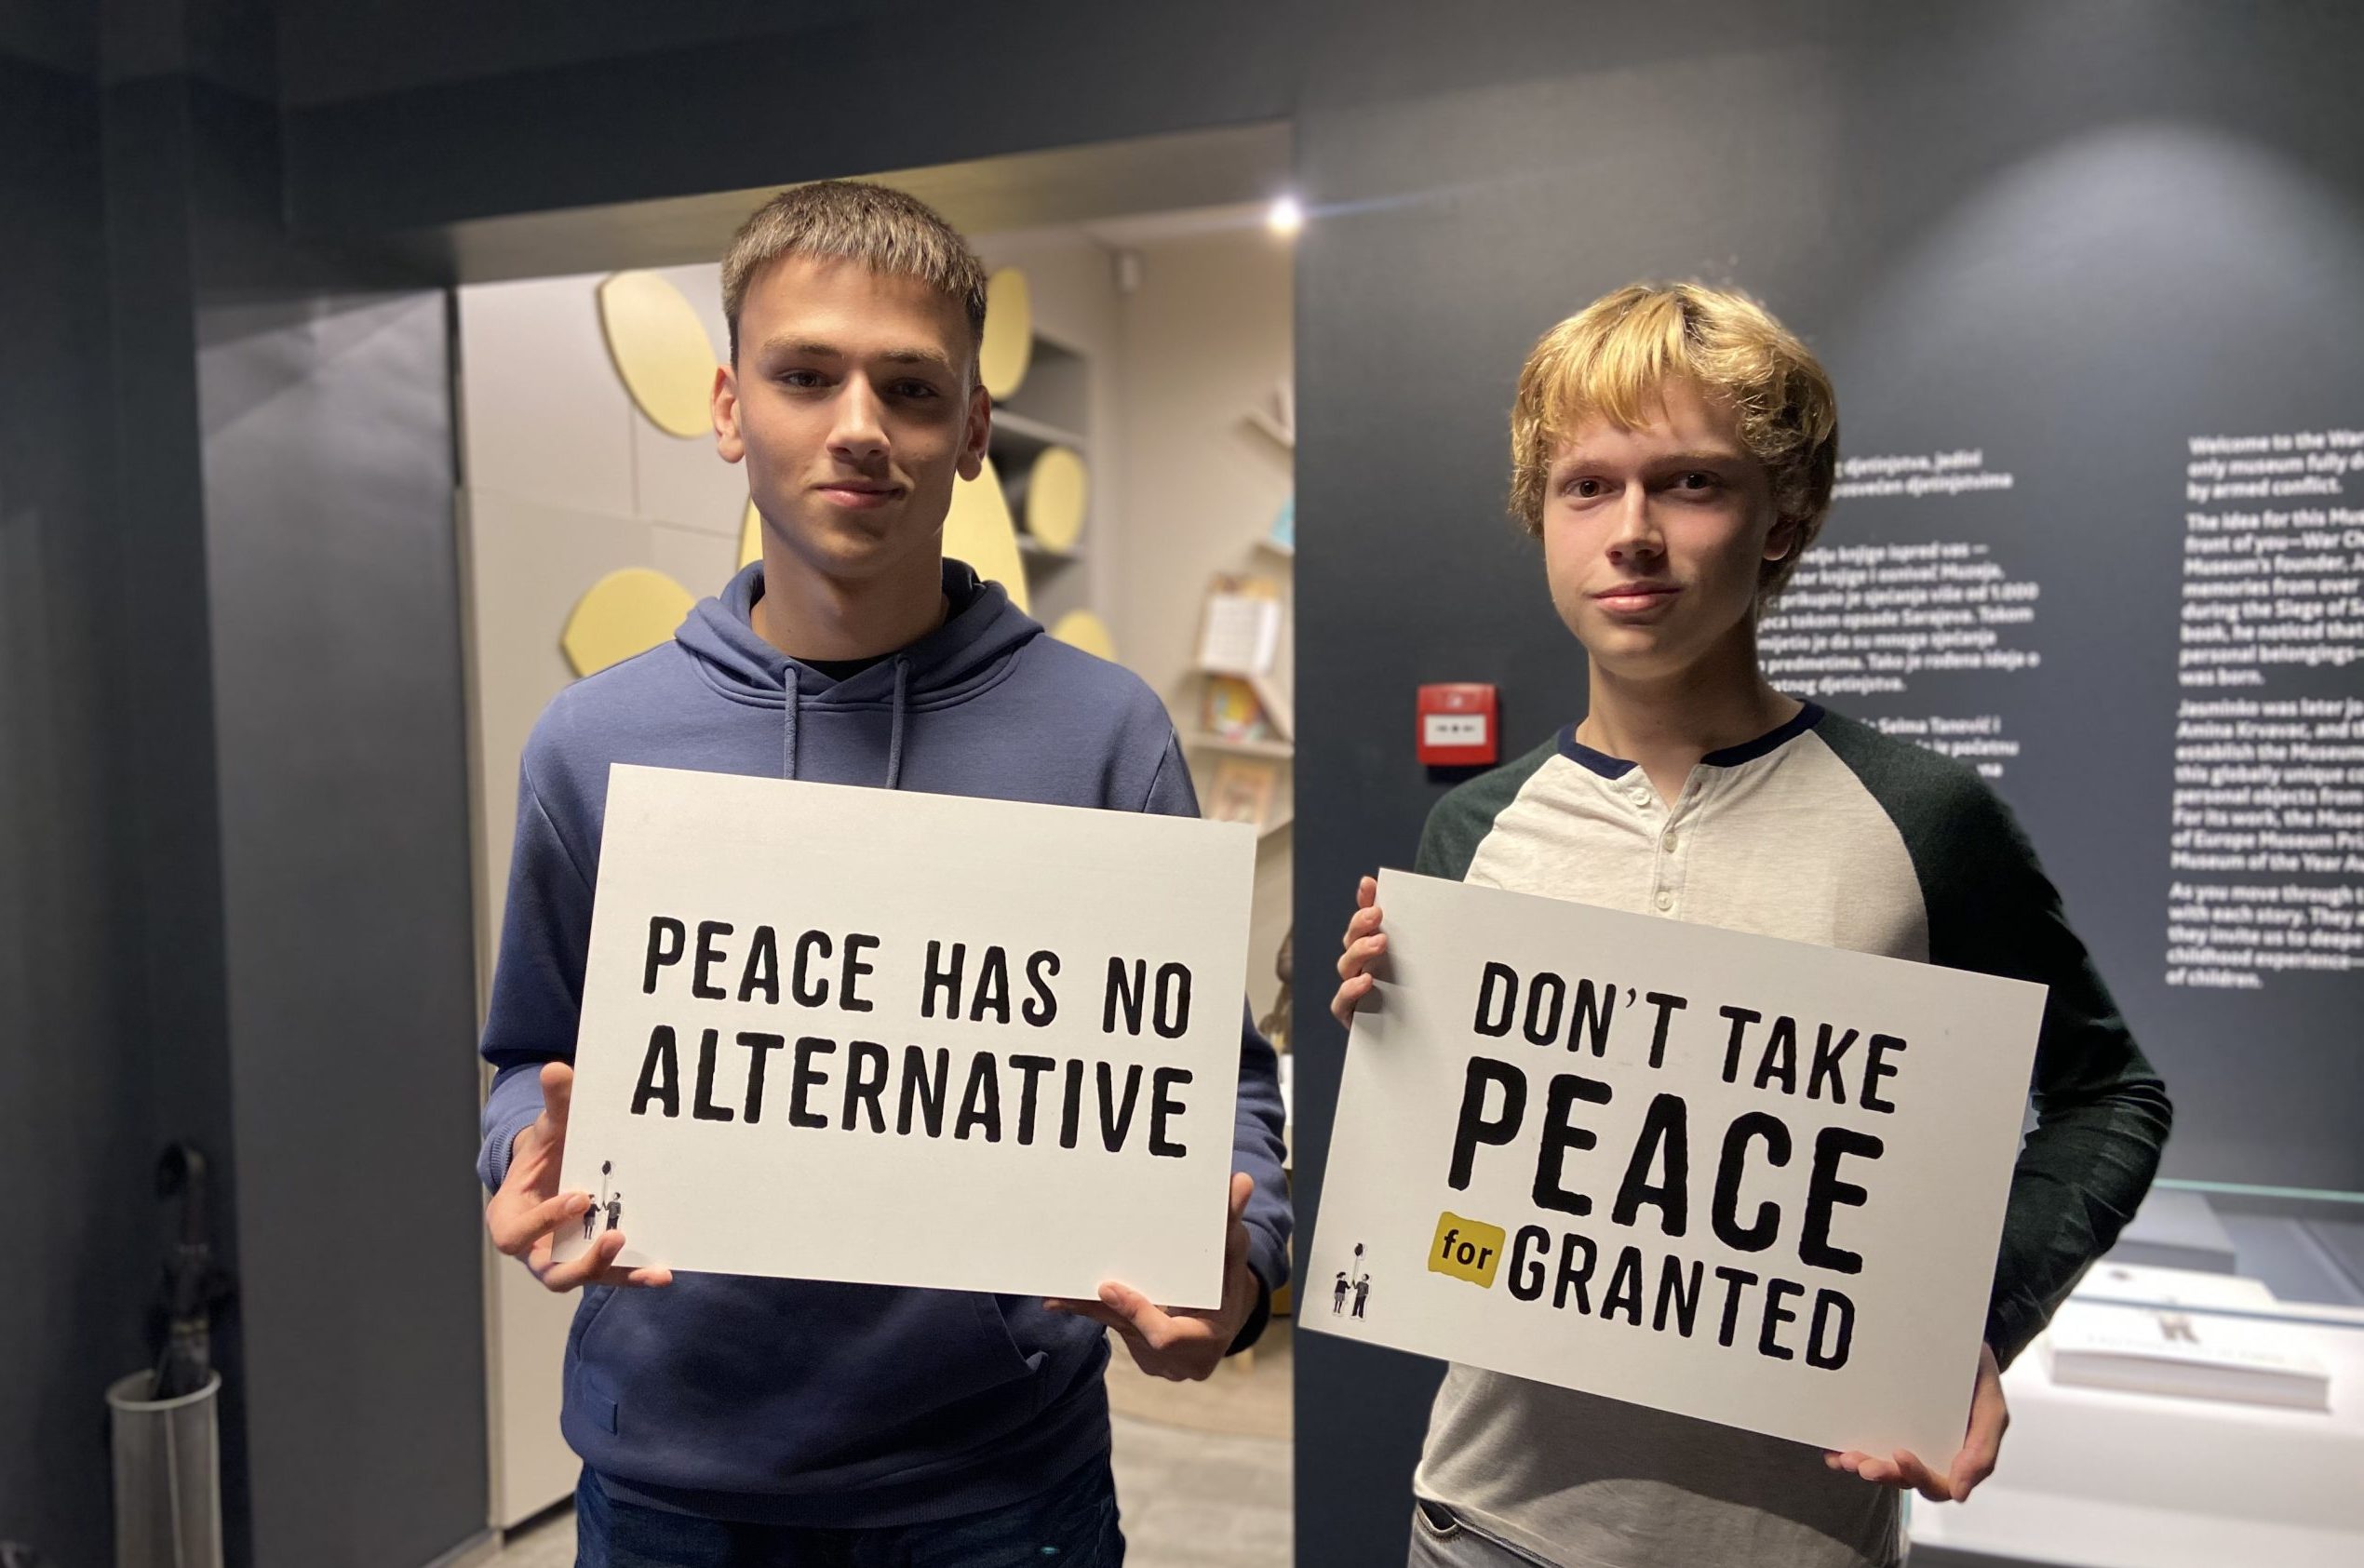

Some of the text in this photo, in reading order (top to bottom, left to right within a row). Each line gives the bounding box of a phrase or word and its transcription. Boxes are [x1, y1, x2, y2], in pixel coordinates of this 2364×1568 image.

[642, 915, 1192, 1040] PEACE HAS NO
[1473, 960, 1908, 1115] DON'T TAKE
[630, 1025, 1194, 1159] ALTERNATIVE
[1447, 1055, 1885, 1275] PEACE
[1441, 1224, 1856, 1372] for GRANTED
